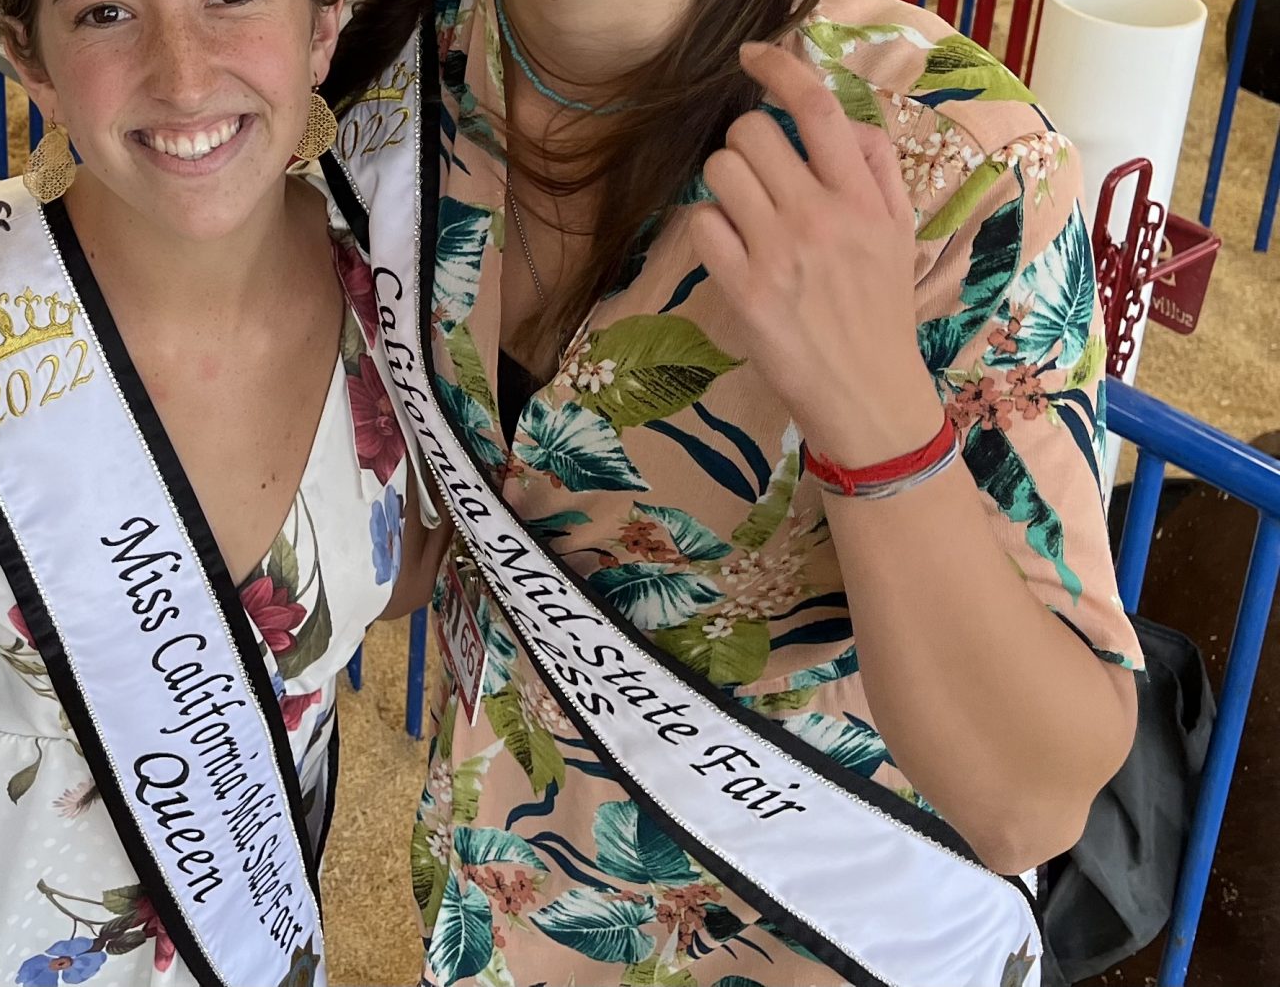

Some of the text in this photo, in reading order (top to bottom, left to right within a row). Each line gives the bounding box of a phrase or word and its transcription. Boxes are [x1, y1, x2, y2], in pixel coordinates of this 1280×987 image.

[337, 106, 410, 162] 022
[372, 266, 493, 524] California
[690, 743, 807, 820] Fair
[100, 516, 182, 633] Miss
[151, 633, 255, 801] California
[259, 883, 303, 954] Fair
[133, 751, 224, 904] Queen
